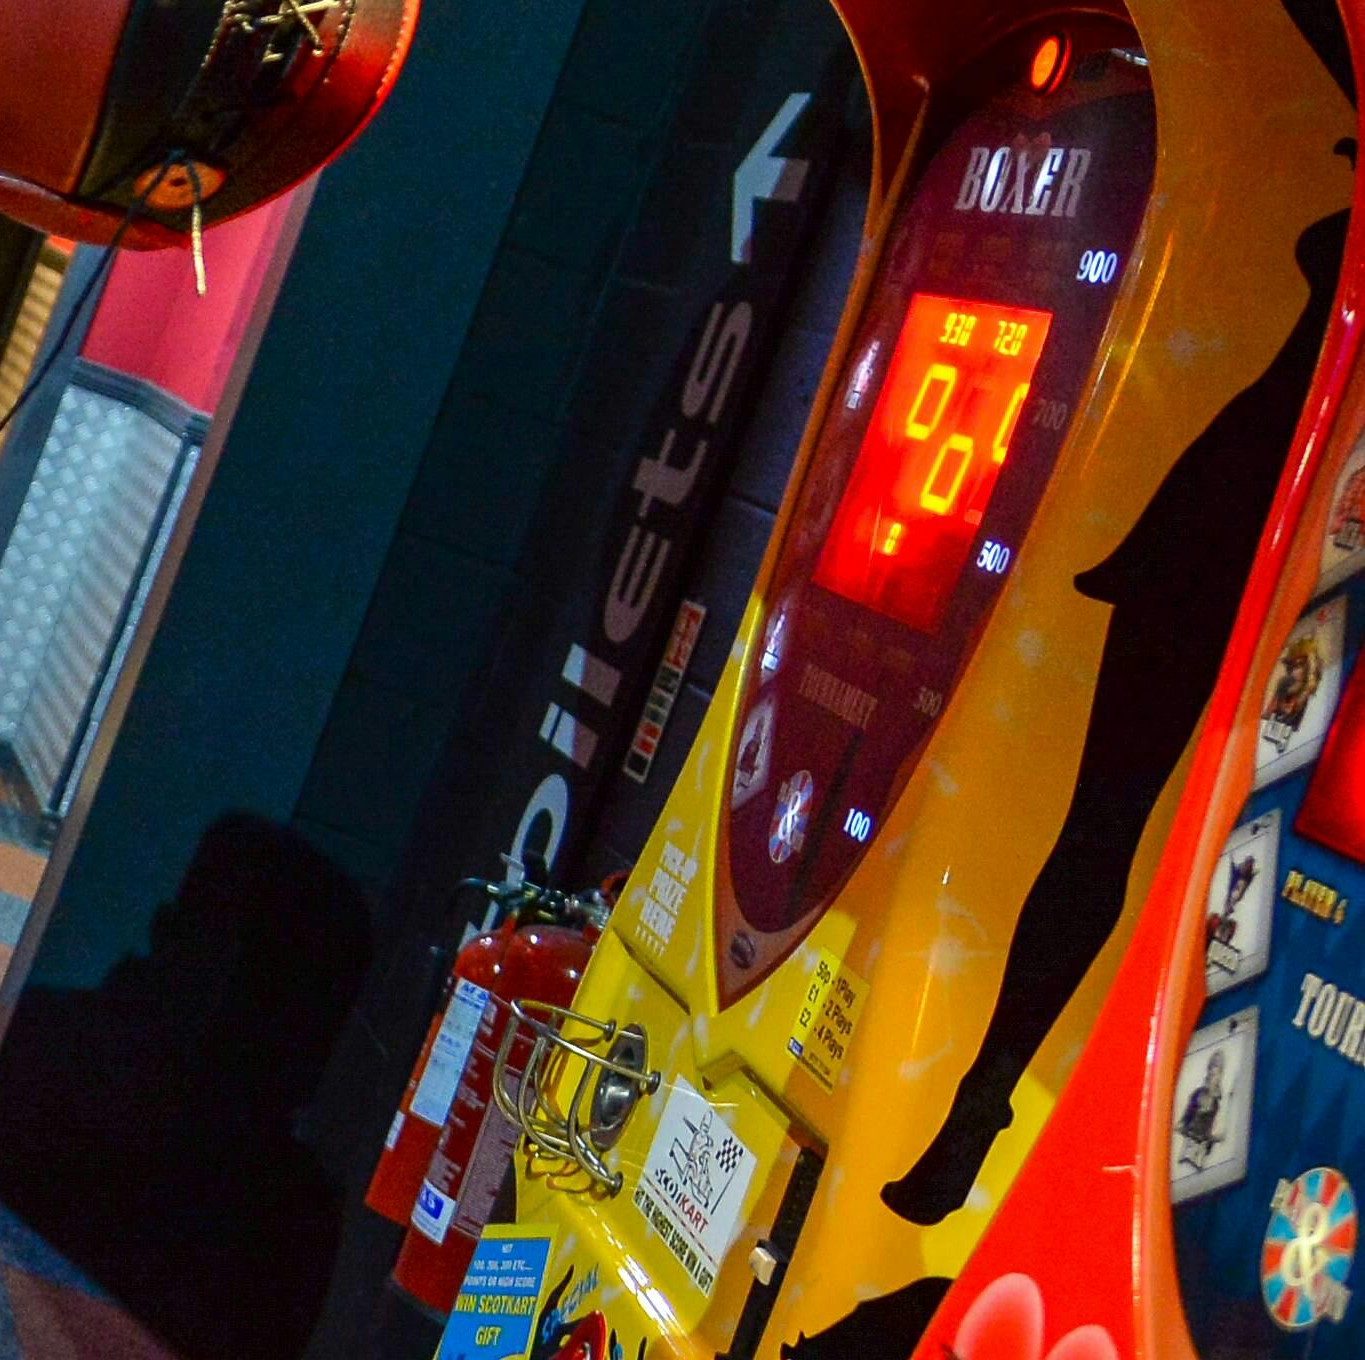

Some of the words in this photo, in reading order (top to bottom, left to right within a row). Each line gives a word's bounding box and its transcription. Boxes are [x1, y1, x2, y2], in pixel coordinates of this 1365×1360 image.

[953, 146, 1091, 217] BOXER
[1076, 250, 1117, 283] 900
[994, 320, 1028, 356] 720
[977, 541, 1010, 574] 500
[458, 300, 753, 952] oilets
[843, 807, 870, 842] 100
[475, 1325, 502, 1346] GIFT
